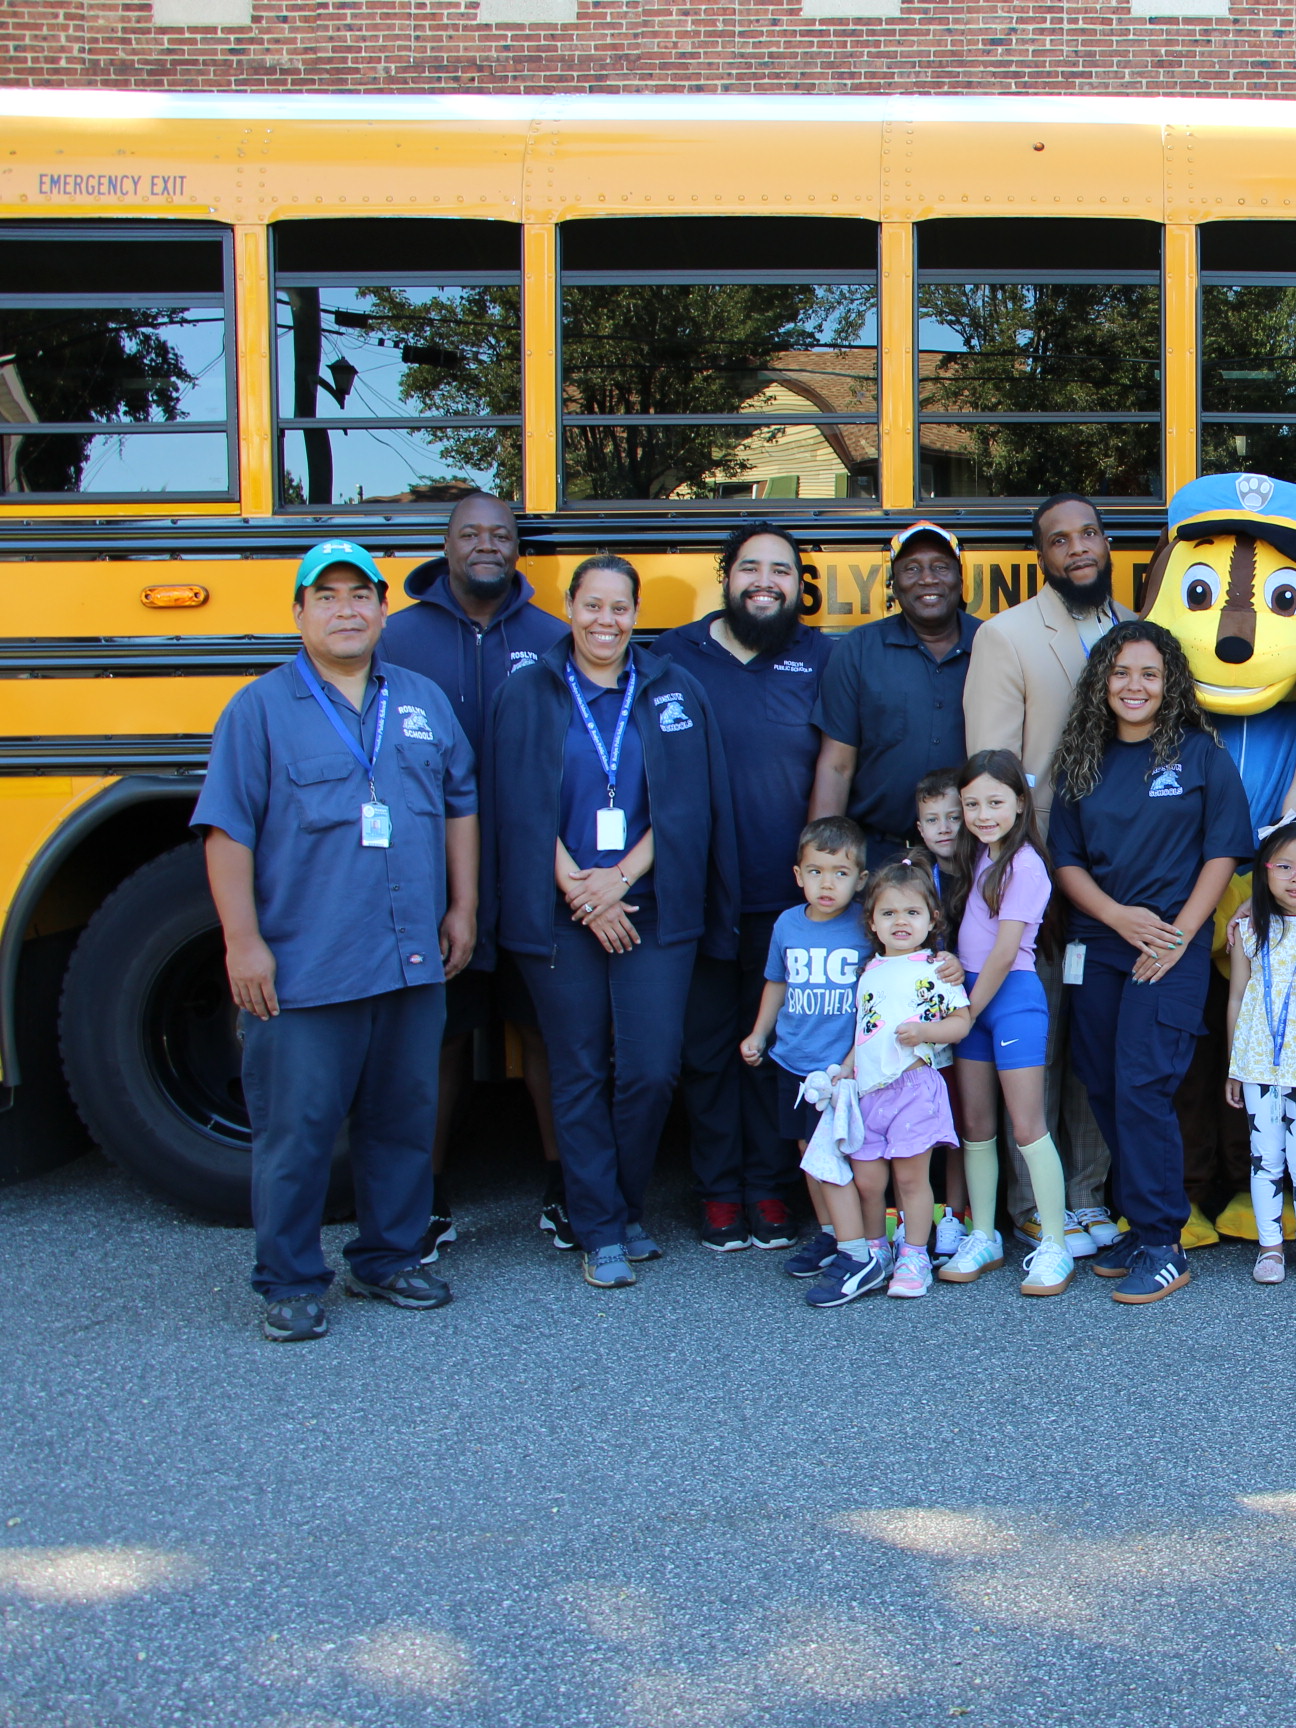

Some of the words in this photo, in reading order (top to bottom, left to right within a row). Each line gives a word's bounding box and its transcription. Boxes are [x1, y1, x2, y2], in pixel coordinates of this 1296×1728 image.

[38, 173, 142, 196] EMERGENCY
[150, 175, 187, 196] EXIT
[510, 650, 538, 661] ROSLYN
[398, 705, 427, 717] ROSLYN
[403, 728, 434, 741] SCHOOLS
[1148, 787, 1183, 797] SCHOOLS
[786, 947, 859, 985] BIG
